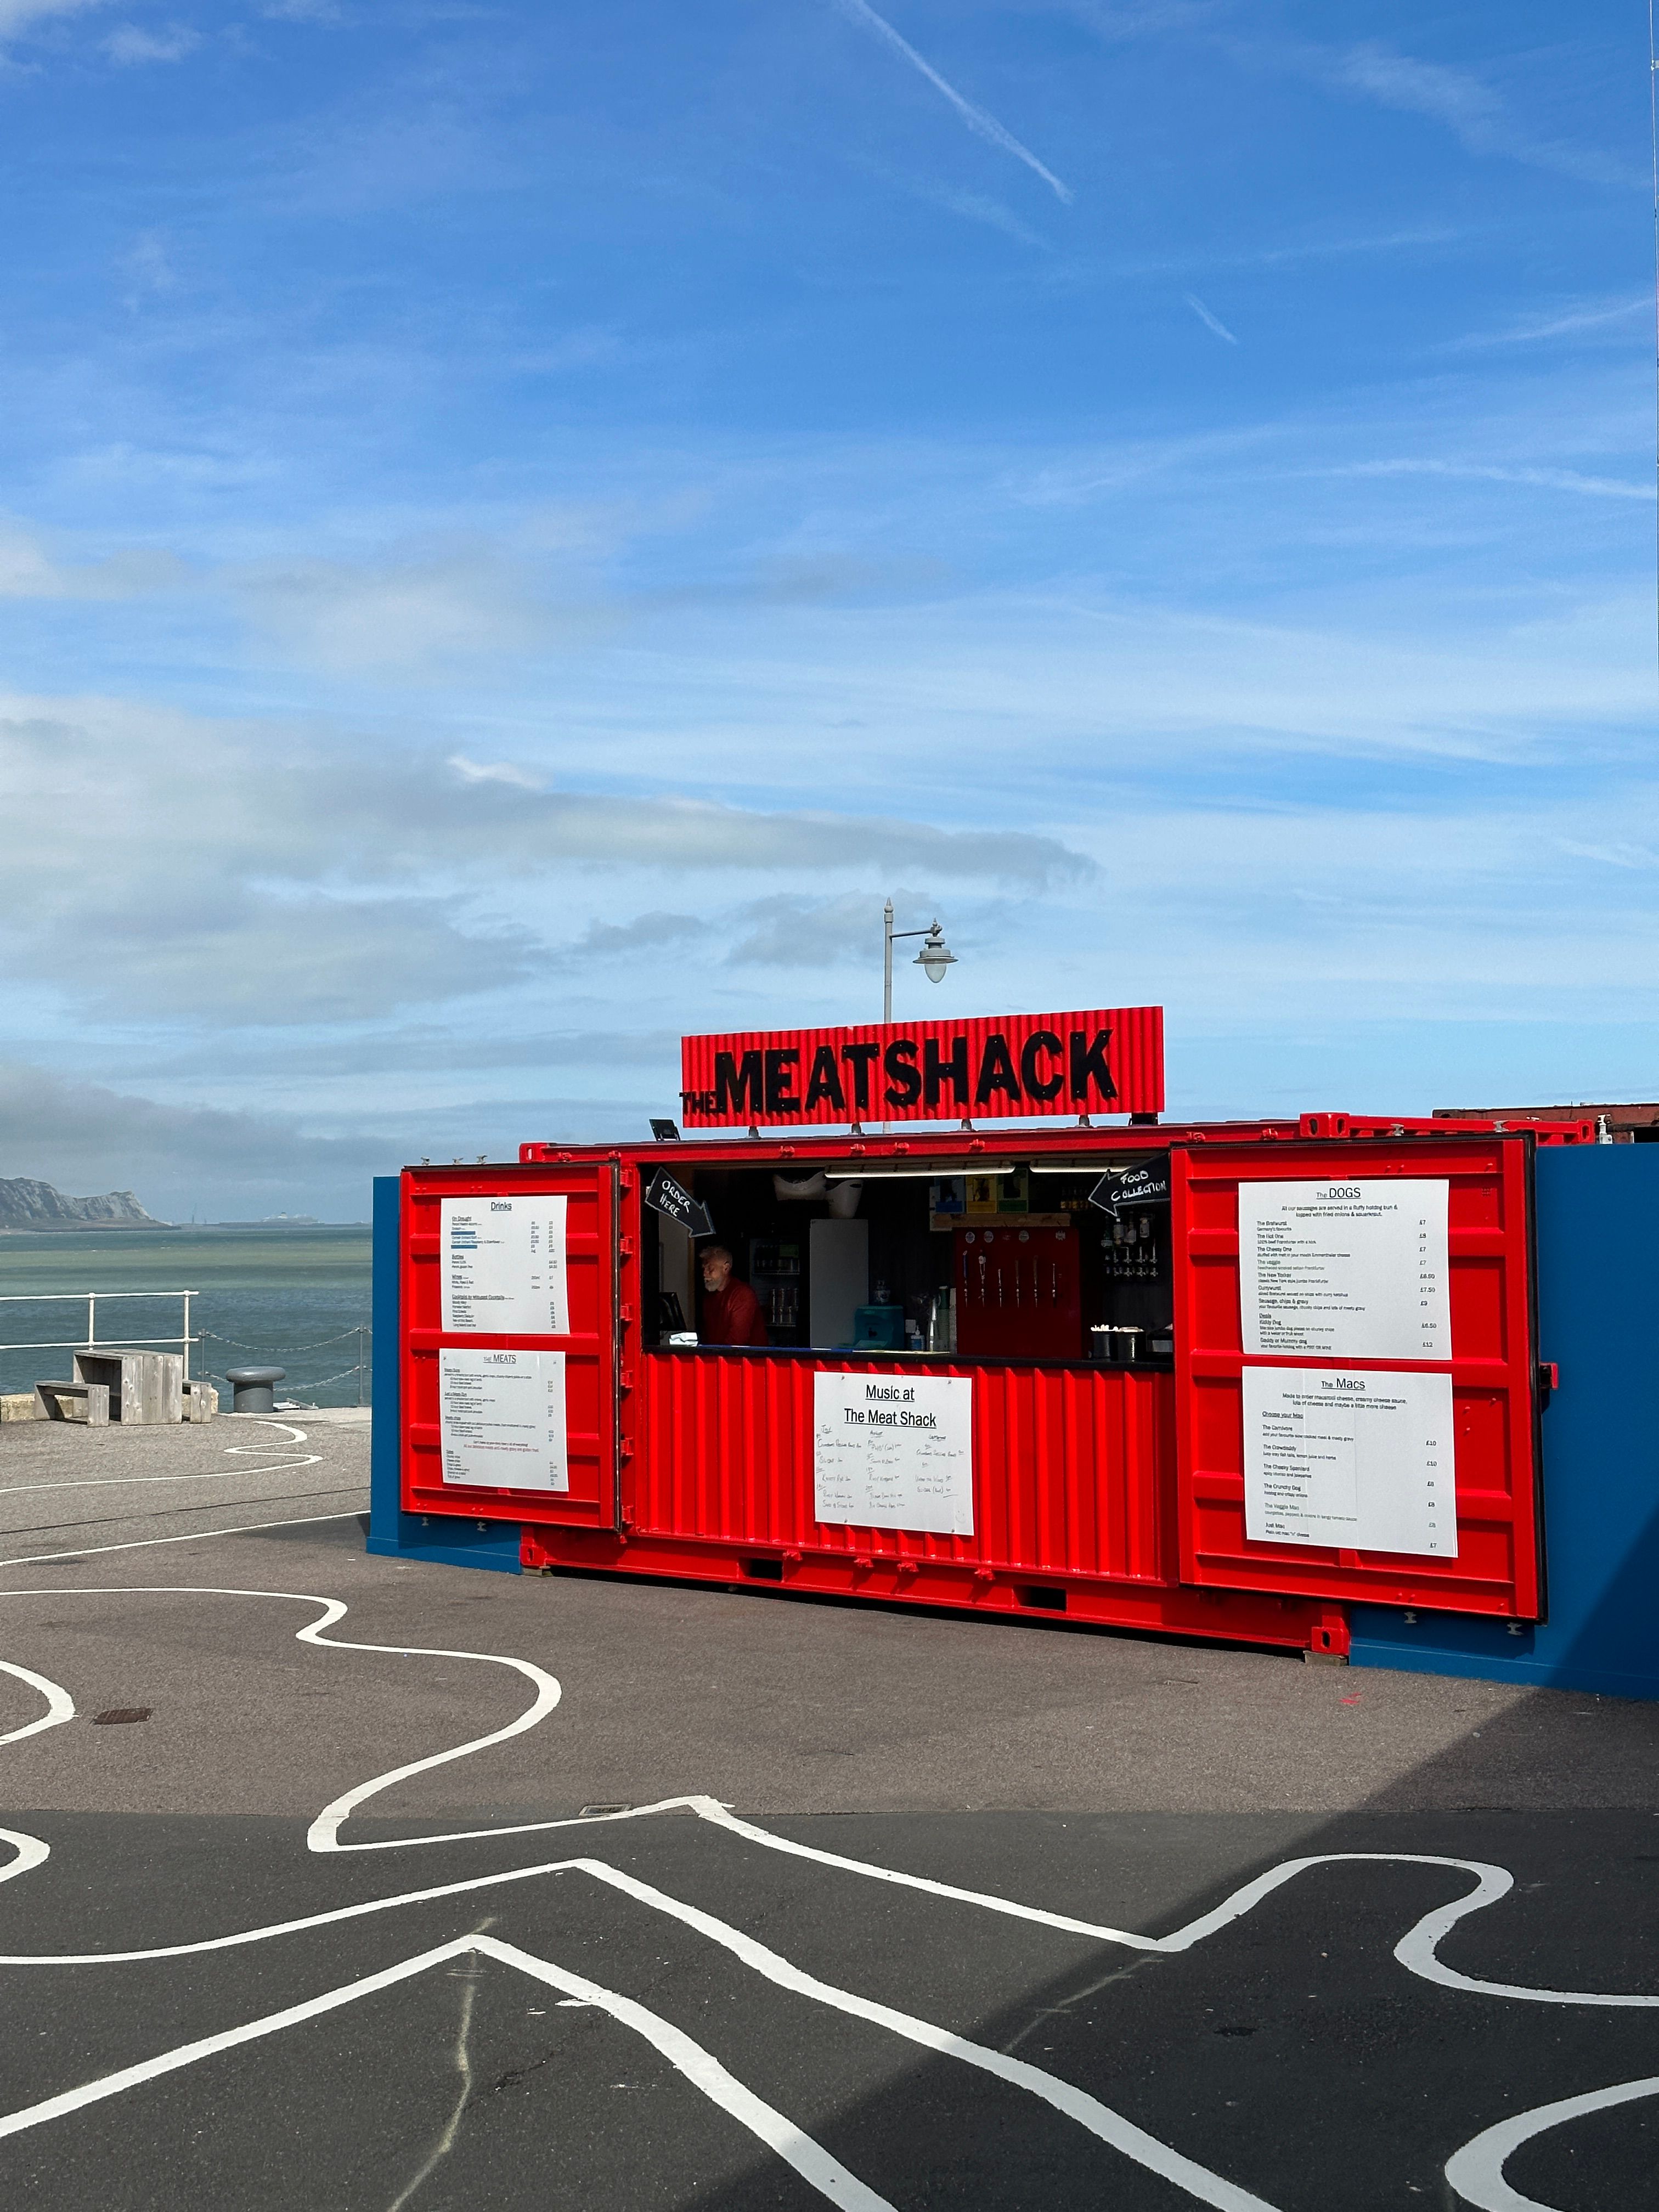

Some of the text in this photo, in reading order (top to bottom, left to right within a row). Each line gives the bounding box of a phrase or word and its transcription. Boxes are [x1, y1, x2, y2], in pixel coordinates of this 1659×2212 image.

[679, 1029, 1118, 1115] THE MEATSHACK
[1120, 1170, 1149, 1184] FOOD
[662, 1181, 690, 1214] ORDER
[1110, 1180, 1167, 1201] COLLECTION
[1329, 1188, 1361, 1198] DOGS
[491, 1201, 512, 1211] Drinks
[659, 1193, 680, 1217] HERE
[493, 1354, 517, 1363] MEATS
[1336, 1378, 1365, 1389] Macs
[866, 1384, 915, 1401] Music at
[844, 1408, 936, 1426] The Meat Shack
